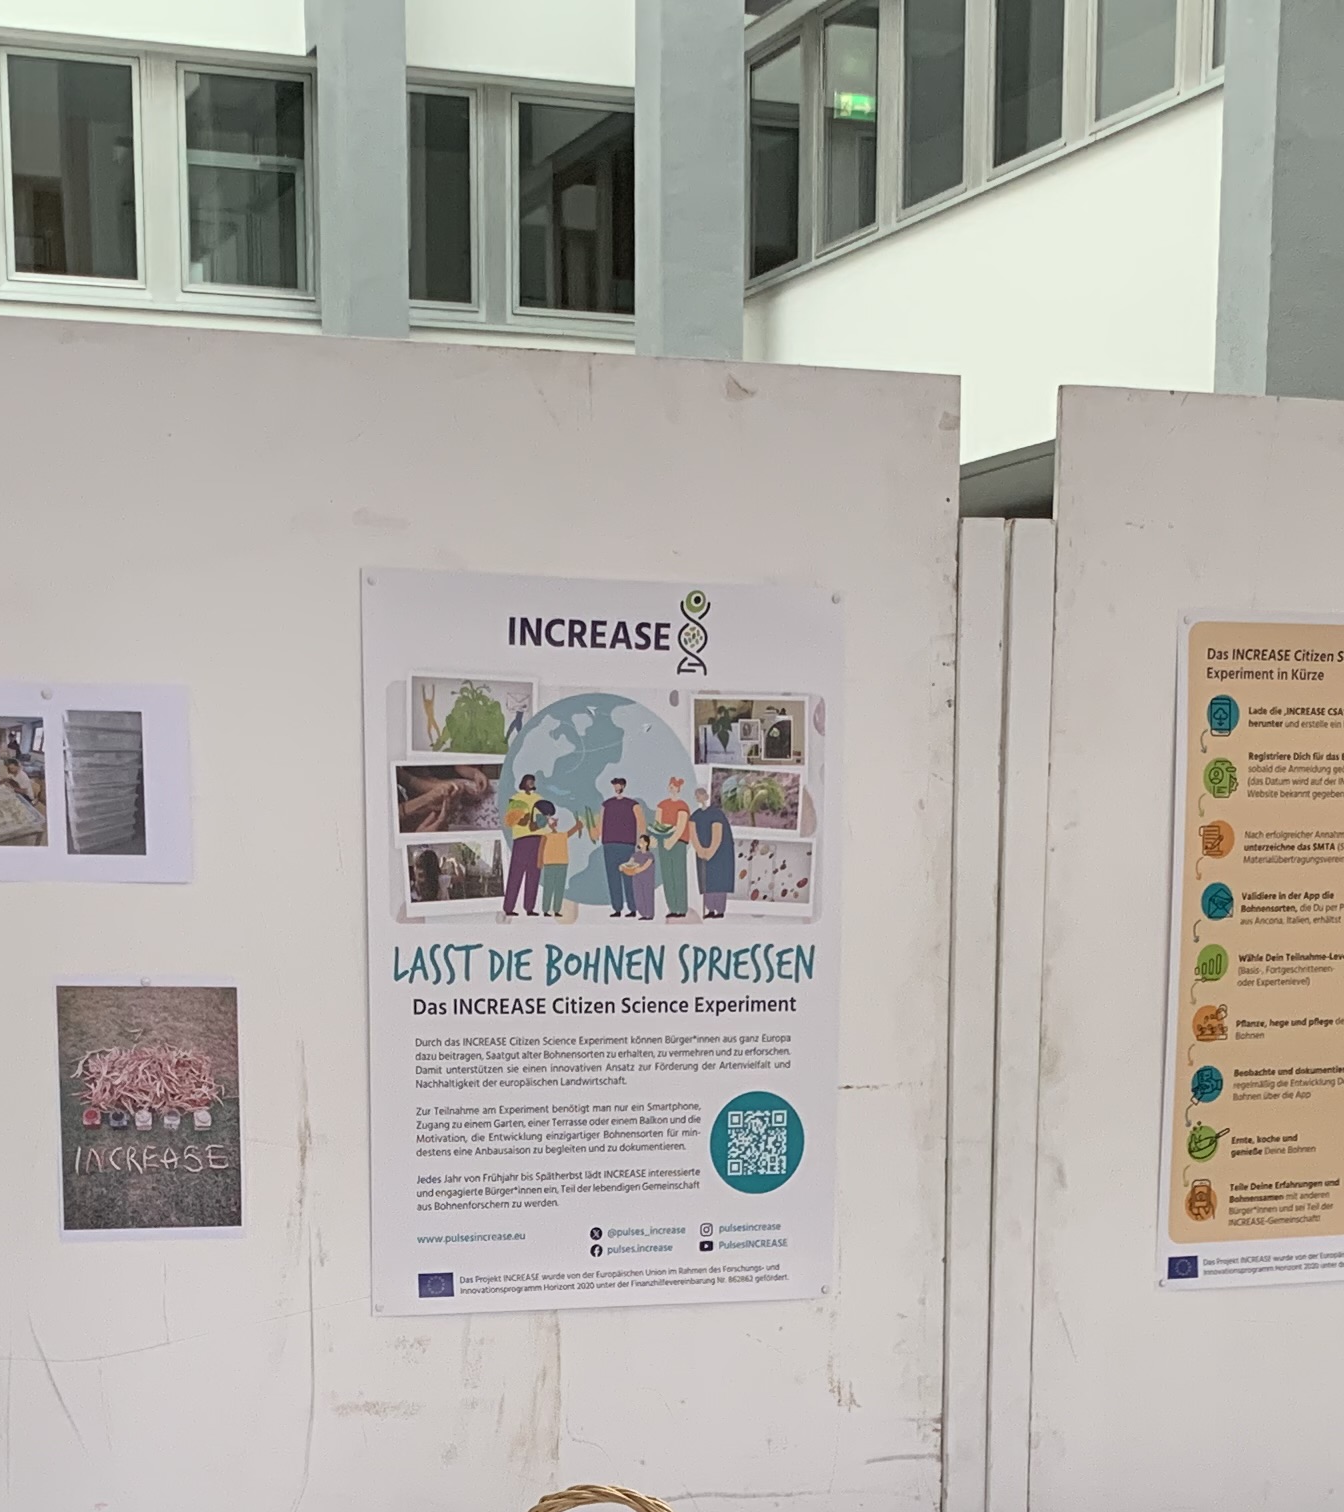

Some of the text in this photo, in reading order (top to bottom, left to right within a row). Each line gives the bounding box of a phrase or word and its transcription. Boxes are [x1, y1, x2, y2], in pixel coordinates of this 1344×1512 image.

[508, 616, 671, 651] INCREASE
[1207, 647, 1229, 660] Das
[1232, 648, 1291, 661] INCREASE
[1293, 648, 1334, 662] Citizen
[1206, 666, 1324, 682] Experiment in Kürze
[393, 943, 815, 986] LASST DIE BOHNEN SPRIESSEN
[413, 994, 796, 1017] Das INCREASE Citizen Science Experiment
[75, 1145, 230, 1174] INCREASE
[607, 1225, 686, 1239] @pulses_increase
[718, 1223, 781, 1234] pulsesincrease
[416, 1232, 526, 1245] www.pulsesincrease.eu
[718, 1237, 788, 1250] PulsesINCREASE
